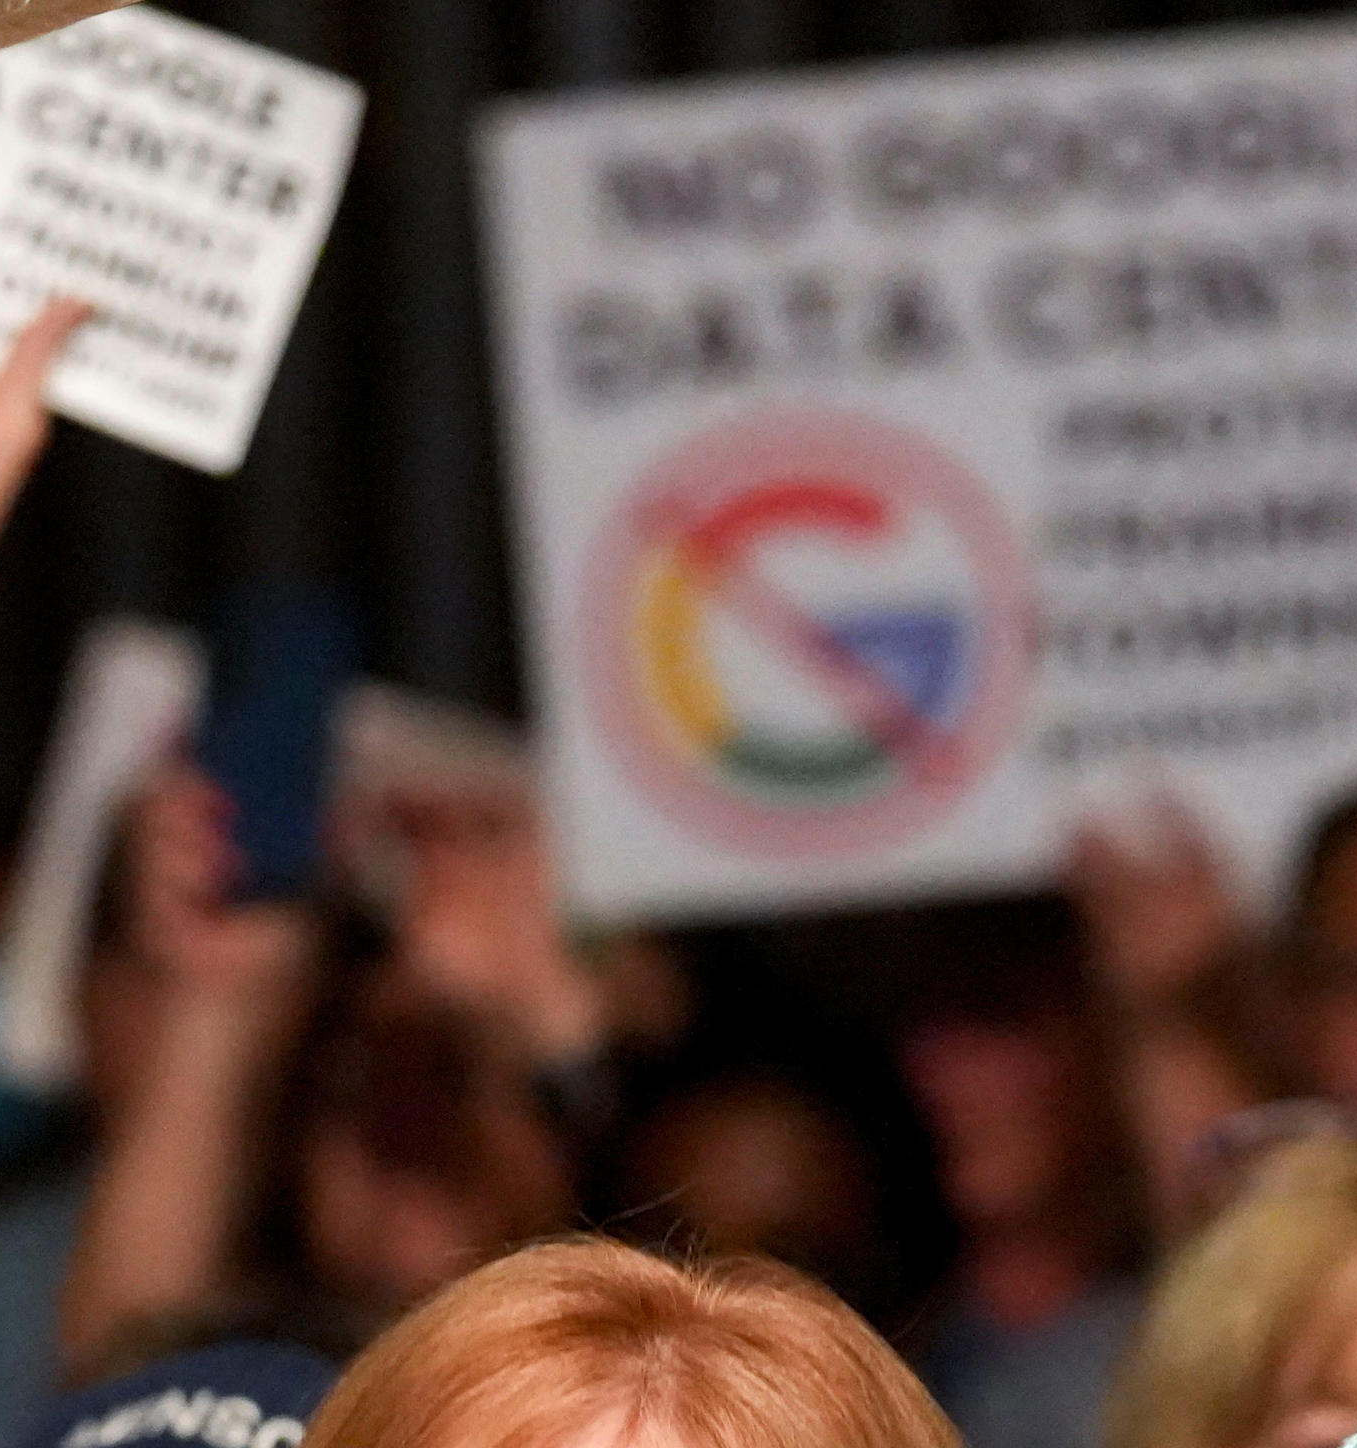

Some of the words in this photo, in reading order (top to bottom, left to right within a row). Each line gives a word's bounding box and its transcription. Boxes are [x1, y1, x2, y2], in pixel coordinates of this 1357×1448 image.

[45, 15, 290, 135] OOGLE
[17, 84, 306, 219] CENTER
[595, 128, 820, 240] NO
[556, 272, 954, 404] DATA
